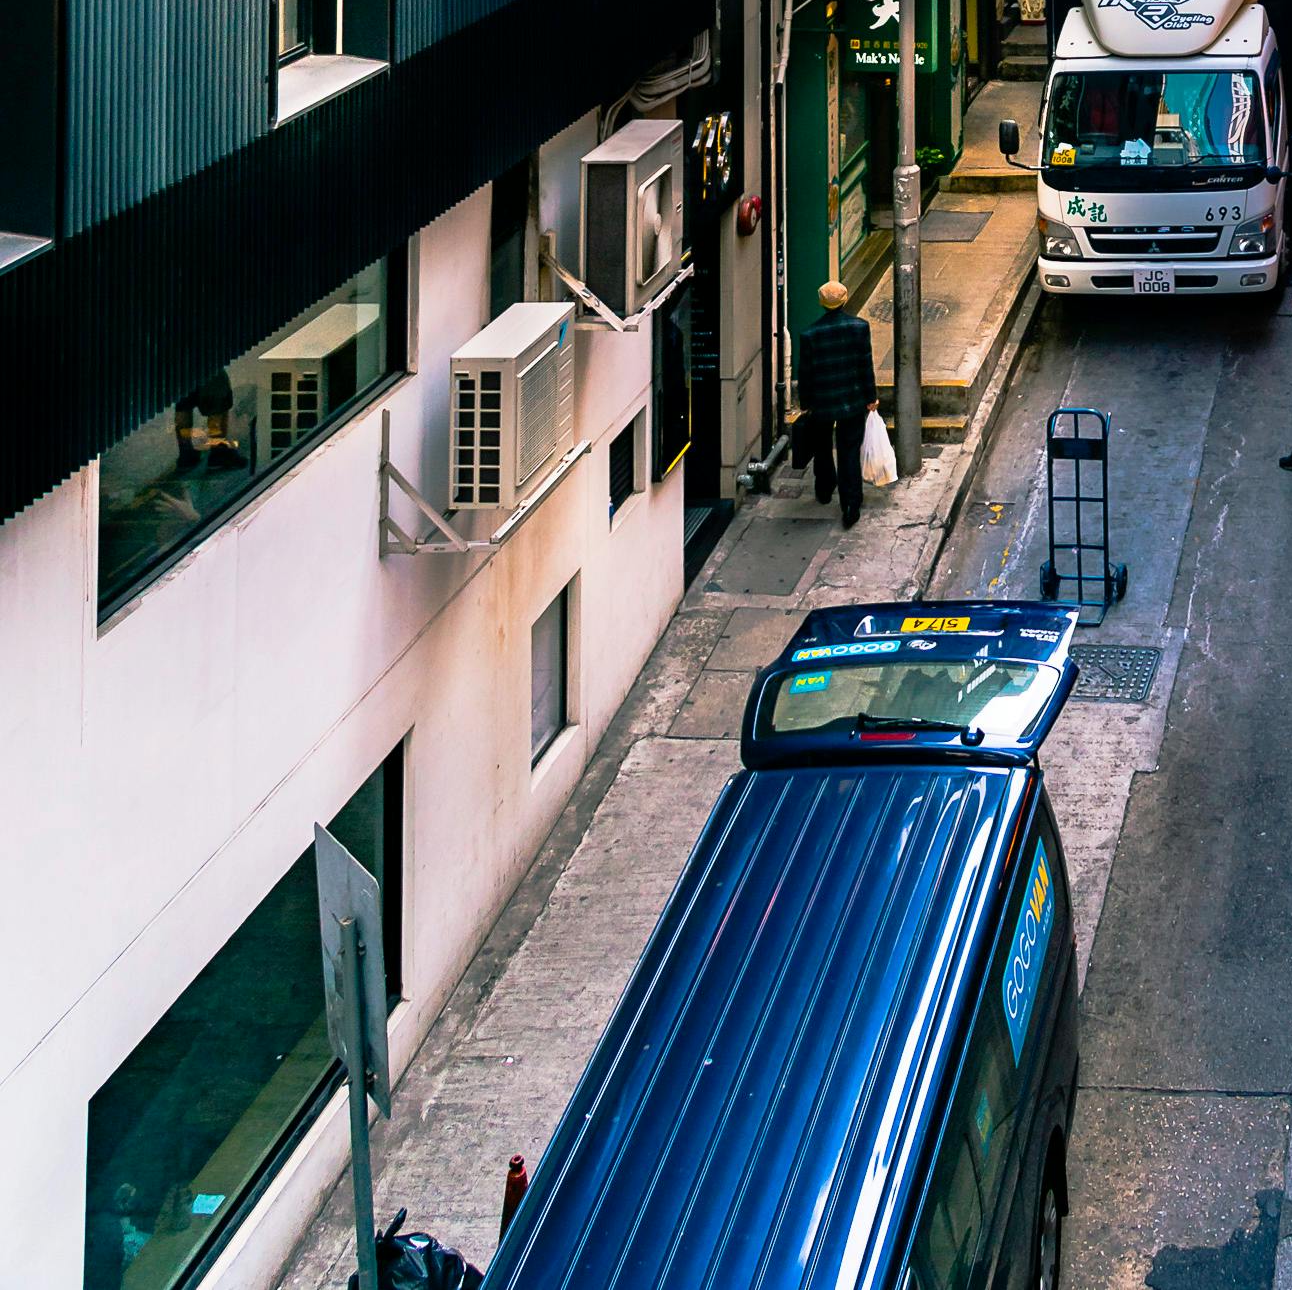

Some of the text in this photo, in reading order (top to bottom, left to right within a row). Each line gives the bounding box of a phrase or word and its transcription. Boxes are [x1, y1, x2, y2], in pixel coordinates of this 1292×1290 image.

[1164, 21, 1190, 29] Club
[1171, 14, 1213, 24] Cycling
[855, 52, 887, 64] Mak's
[1052, 156, 1073, 164] 1008
[1067, 195, 1107, 223] 成記
[1205, 206, 1242, 222] 693
[1112, 225, 1195, 233] FUSO
[1144, 270, 1165, 282] JC
[1138, 282, 1170, 293] 1008
[796, 640, 898, 660] GOGOVAN
[796, 674, 825, 687] VAN
[1007, 857, 1049, 1019] GOGOVAN
